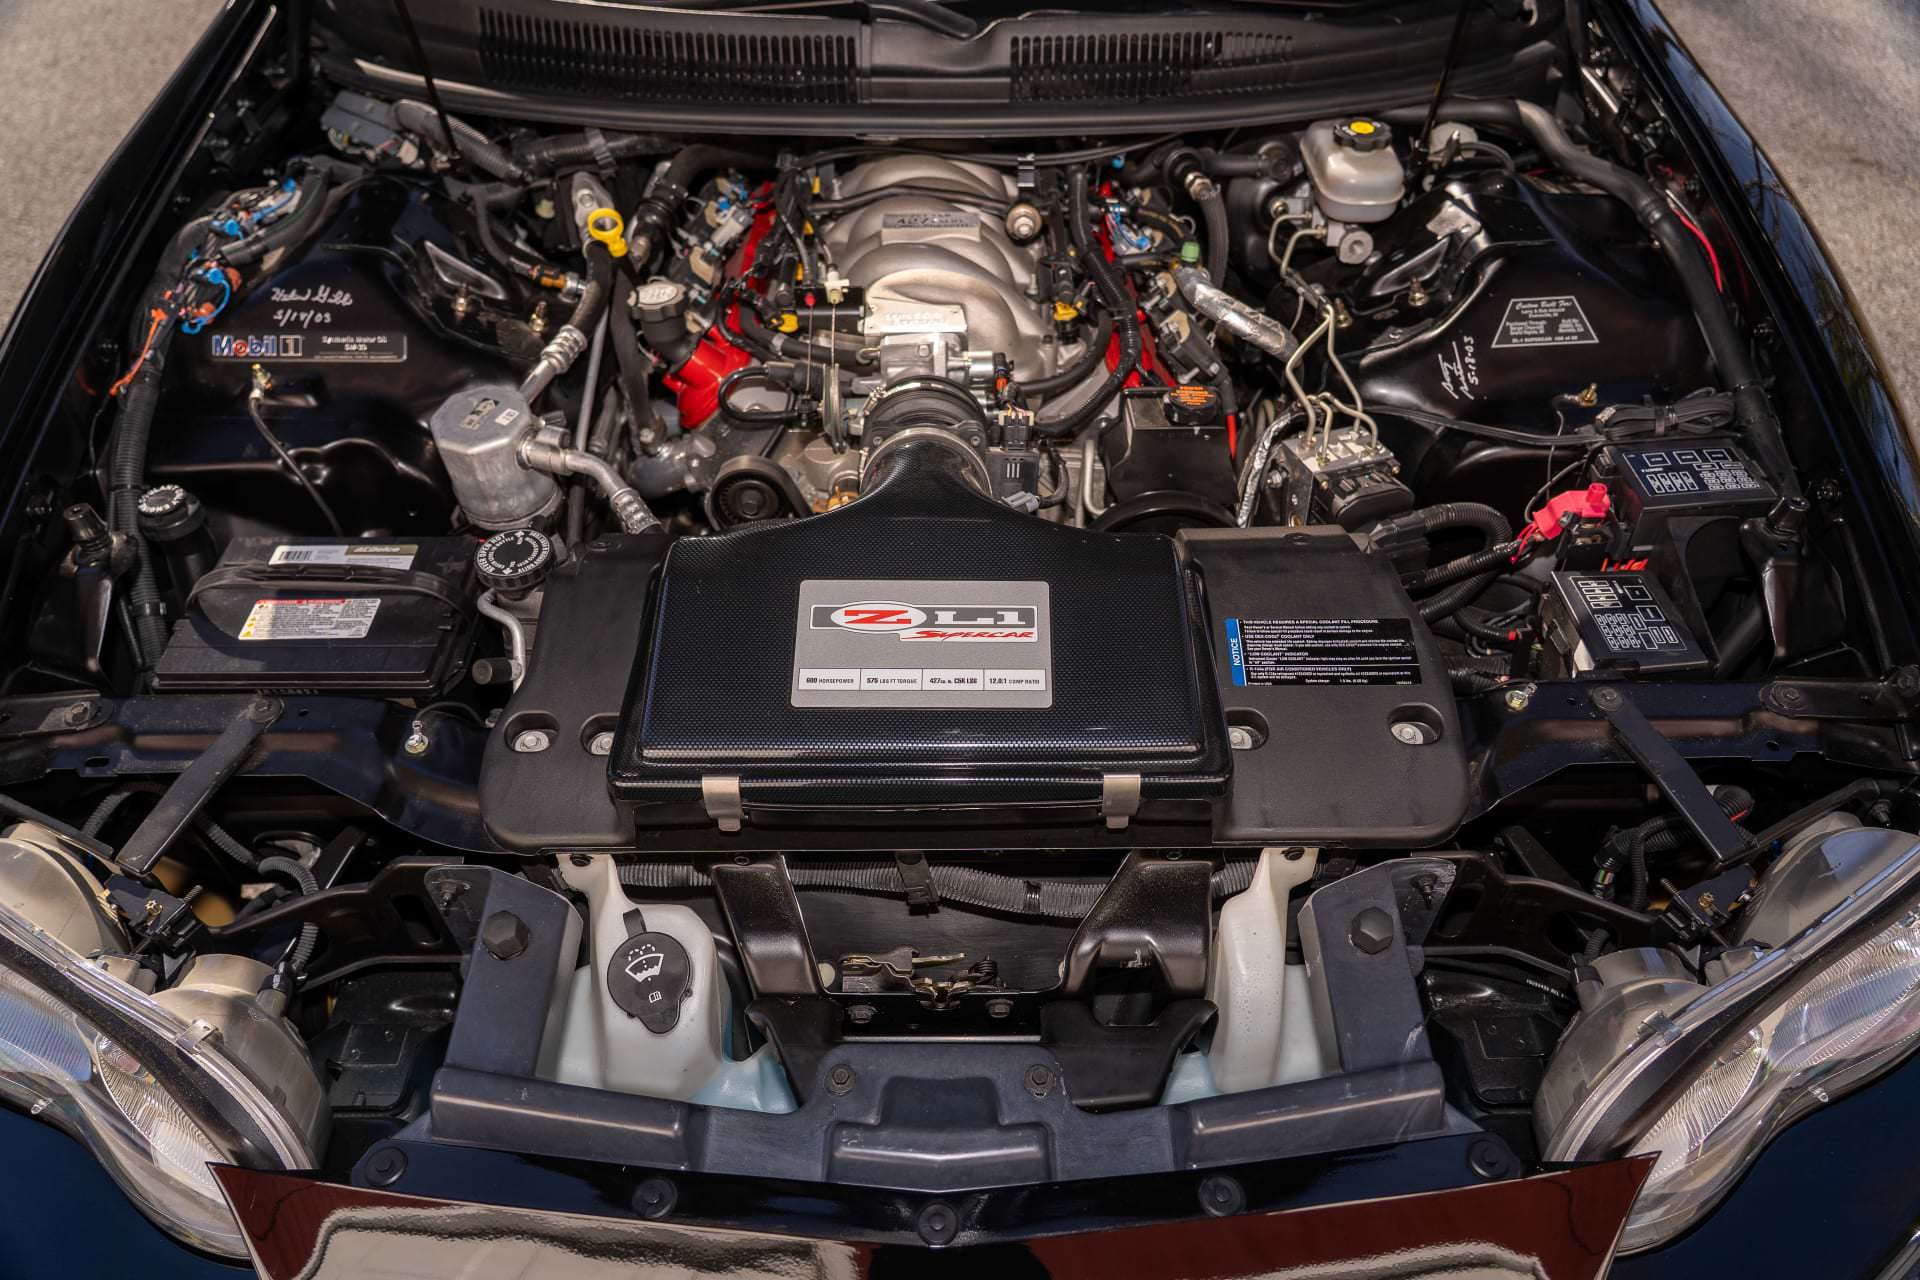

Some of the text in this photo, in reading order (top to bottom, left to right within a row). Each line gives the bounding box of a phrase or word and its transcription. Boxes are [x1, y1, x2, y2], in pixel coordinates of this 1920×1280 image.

[212, 335, 277, 357] Mobil
[844, 609, 1026, 625] ZL1
[1230, 637, 1241, 667] NOTICE
